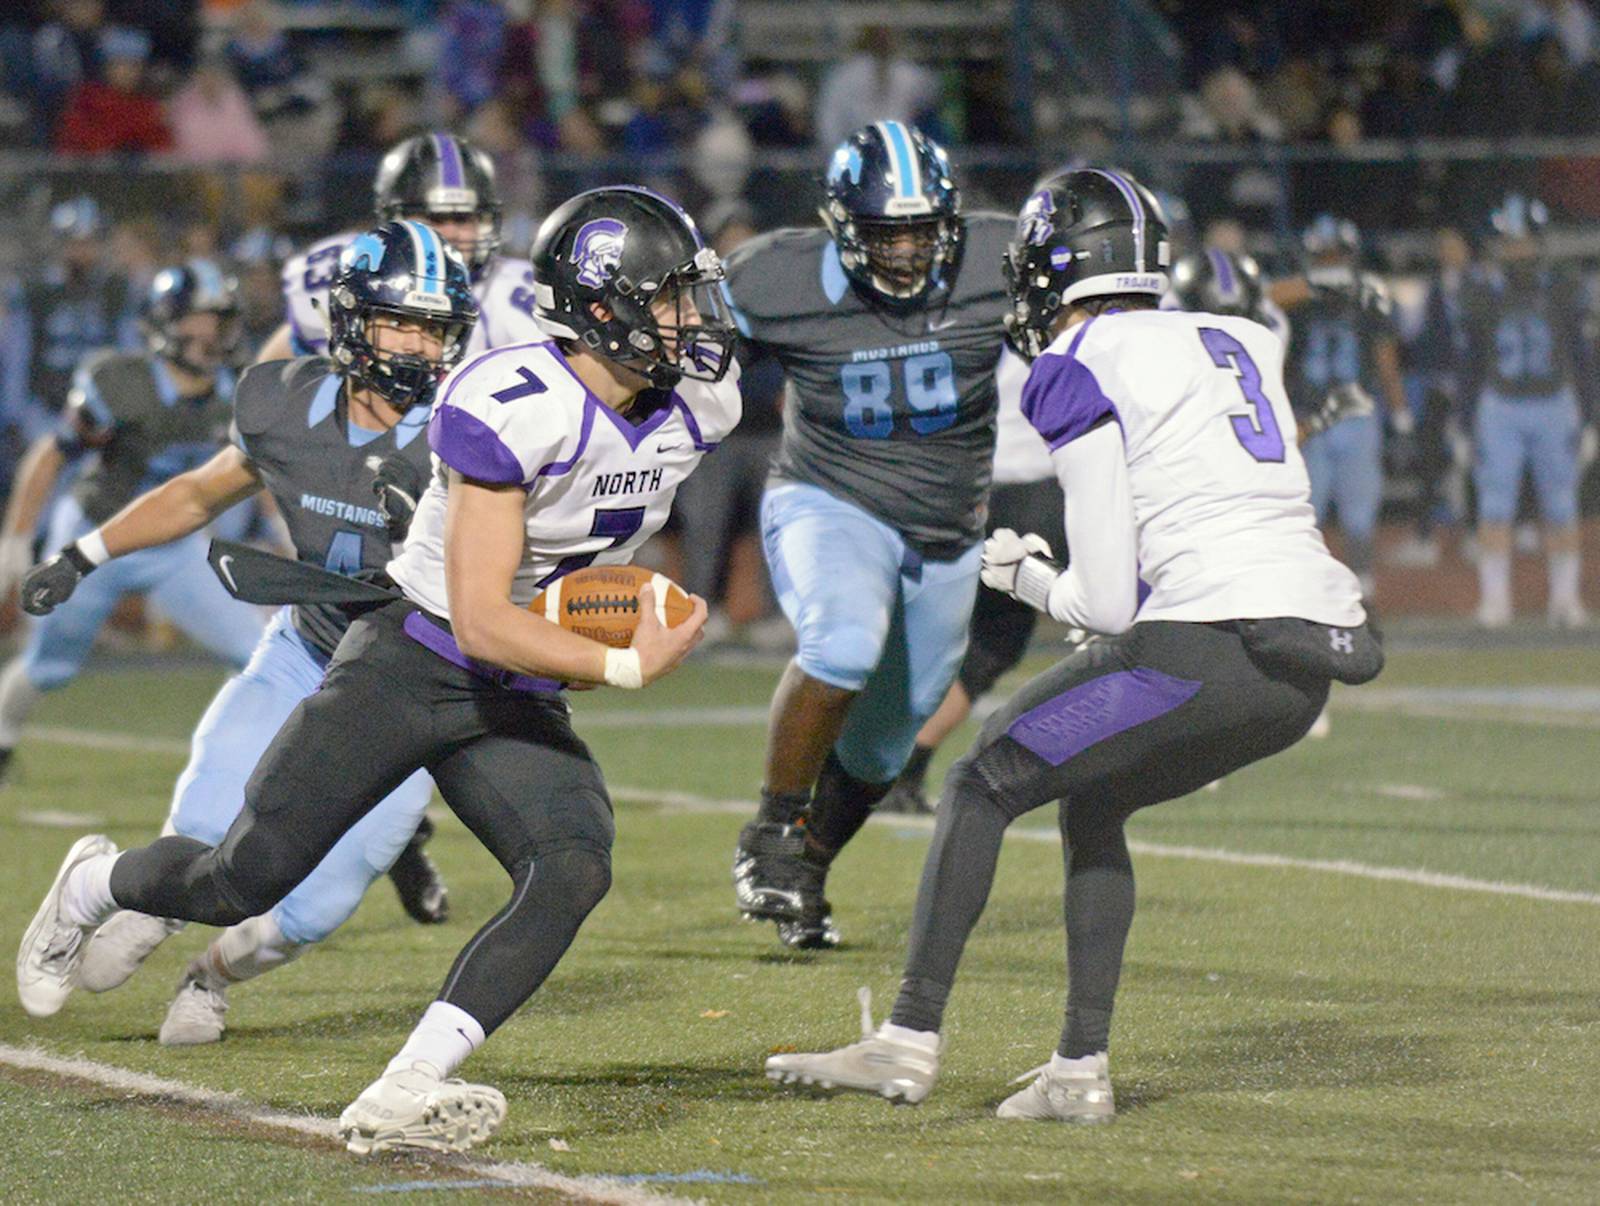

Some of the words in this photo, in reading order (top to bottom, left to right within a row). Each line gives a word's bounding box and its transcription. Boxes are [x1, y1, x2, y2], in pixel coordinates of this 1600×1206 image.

[490, 366, 548, 404] 7
[840, 351, 959, 439] 89
[1197, 327, 1285, 463] 3
[300, 493, 386, 529] MUSTANGS
[592, 468, 663, 497] NORTH
[534, 506, 647, 590] 7
